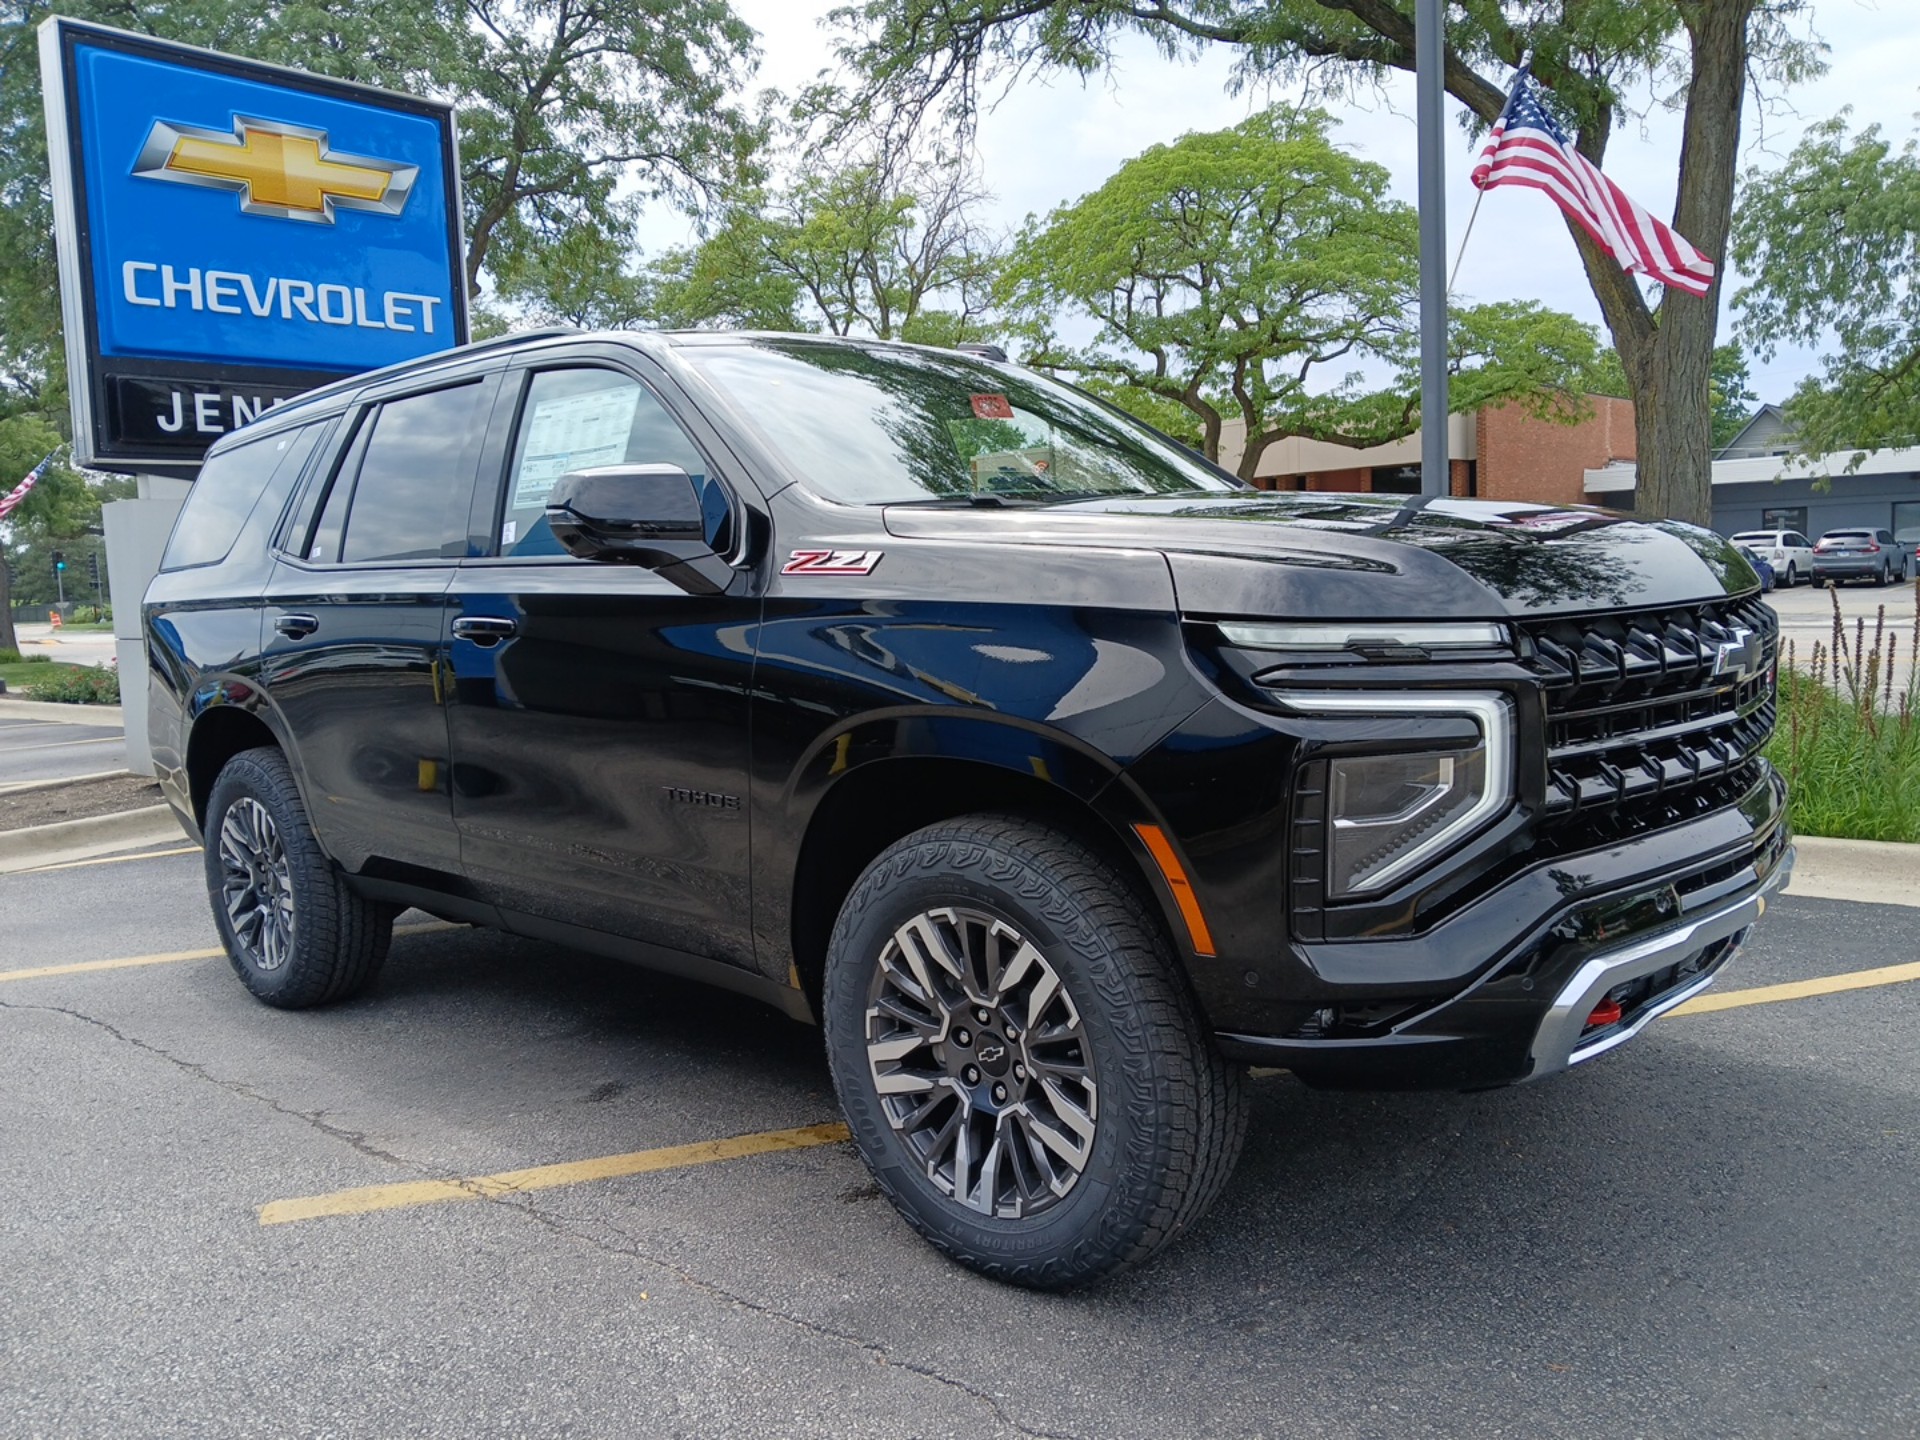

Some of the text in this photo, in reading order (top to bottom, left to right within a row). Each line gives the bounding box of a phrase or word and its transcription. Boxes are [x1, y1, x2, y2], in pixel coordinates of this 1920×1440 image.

[122, 260, 441, 333] CHEVROLET
[156, 391, 285, 434] JEN
[780, 549, 885, 577] Z71
[661, 786, 741, 810] TAHOE
[973, 1232, 1055, 1251] TERRITORY
